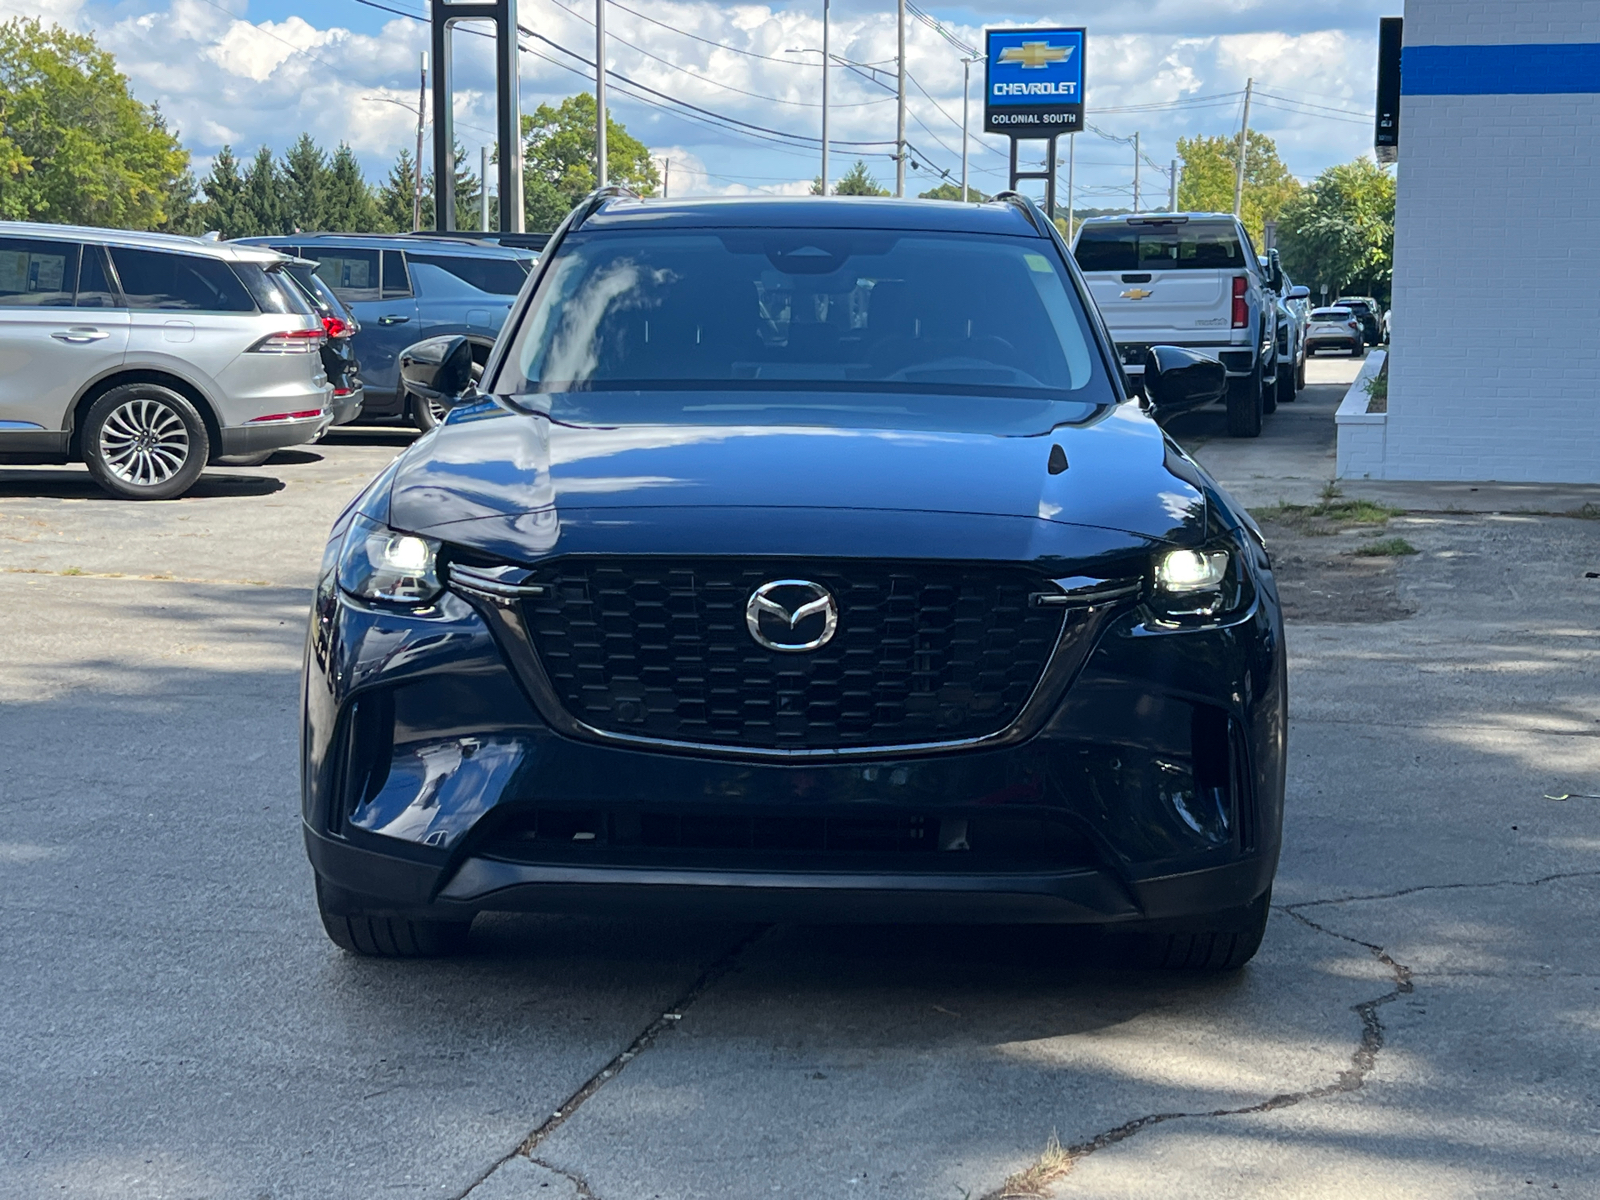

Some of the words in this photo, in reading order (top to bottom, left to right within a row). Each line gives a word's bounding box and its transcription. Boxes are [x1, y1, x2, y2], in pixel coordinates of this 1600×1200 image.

[993, 82, 1077, 95] CHEVROLET
[991, 114, 1040, 124] COLONIAL
[1042, 113, 1077, 123] SOUTH
